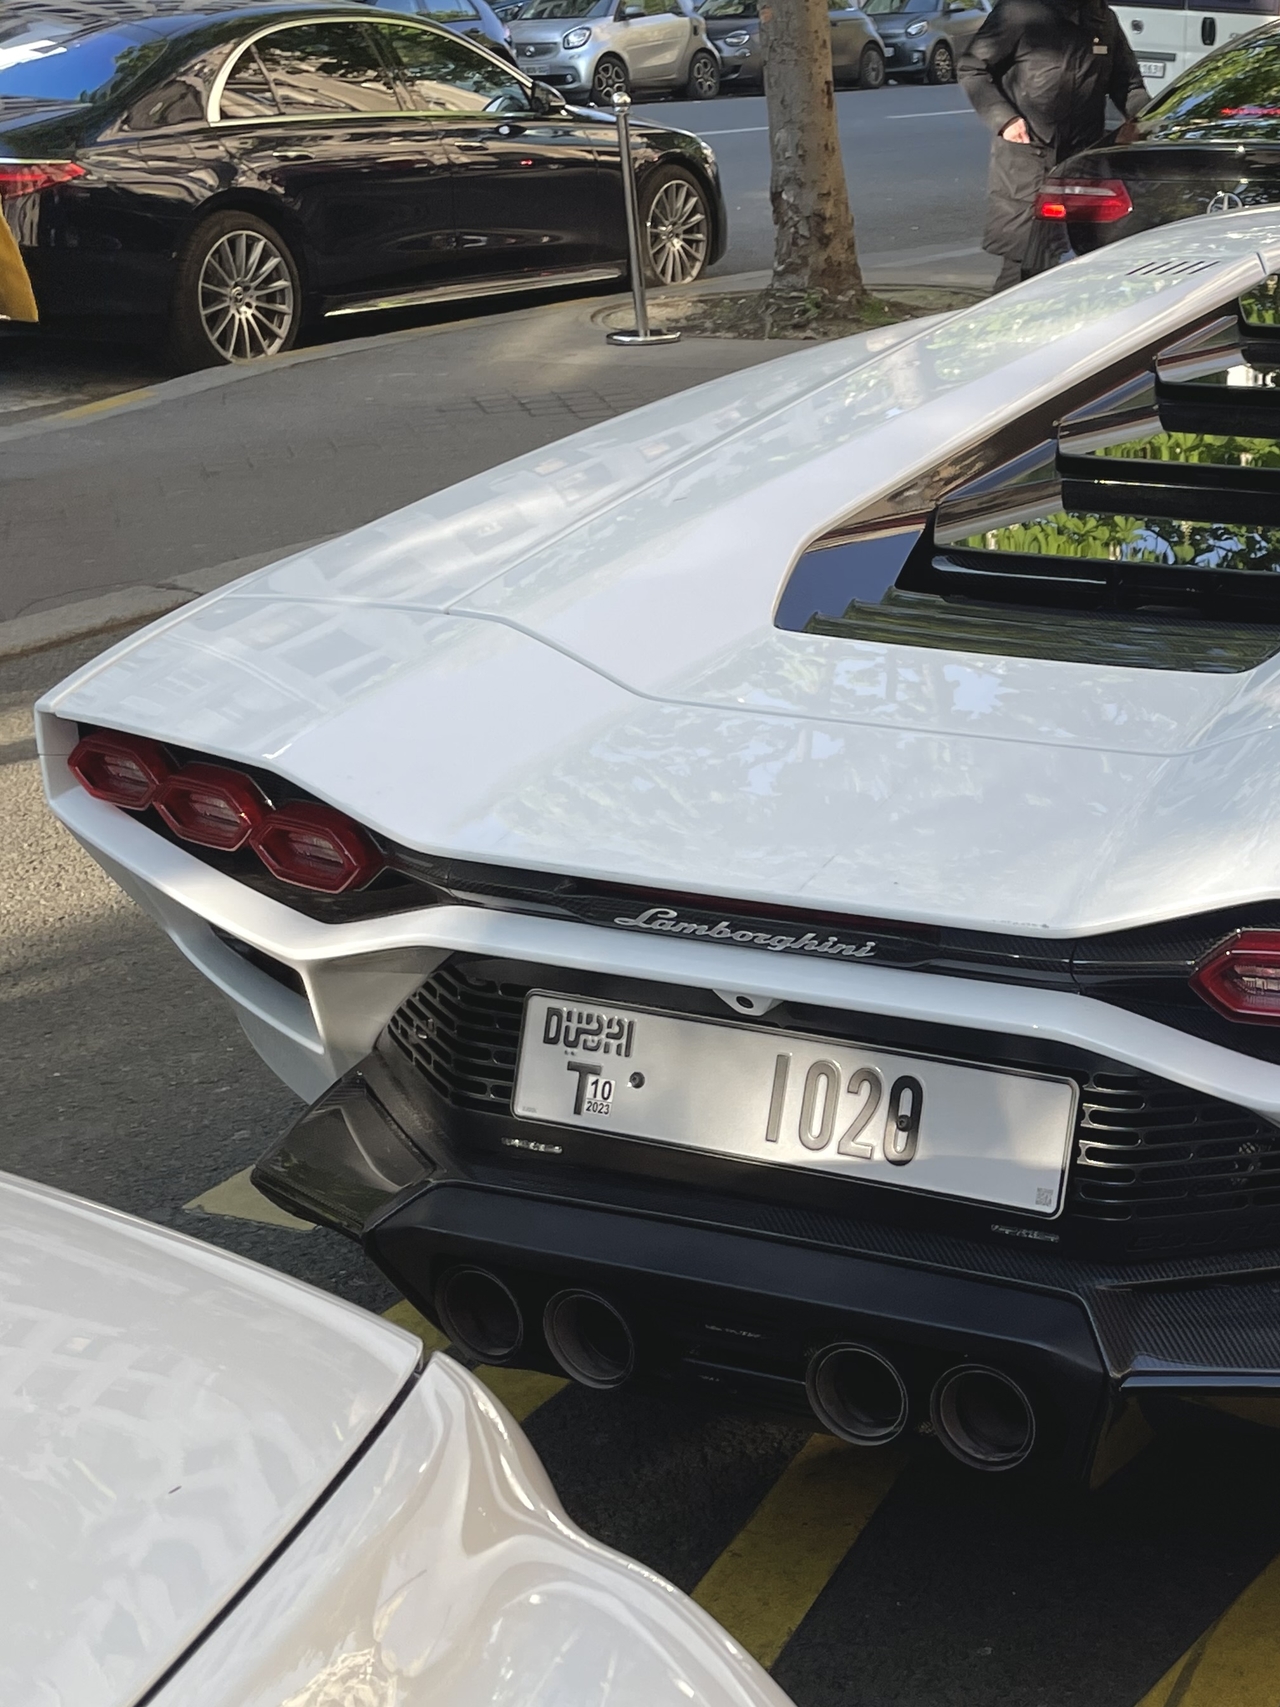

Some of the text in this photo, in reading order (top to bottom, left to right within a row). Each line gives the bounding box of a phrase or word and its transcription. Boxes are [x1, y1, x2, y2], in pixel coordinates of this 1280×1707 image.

[613, 908, 876, 958] Lamborghini
[566, 1060, 603, 1116] T
[585, 1101, 611, 1115] 2023
[590, 1078, 613, 1101] 10
[765, 1054, 924, 1167] 1020
